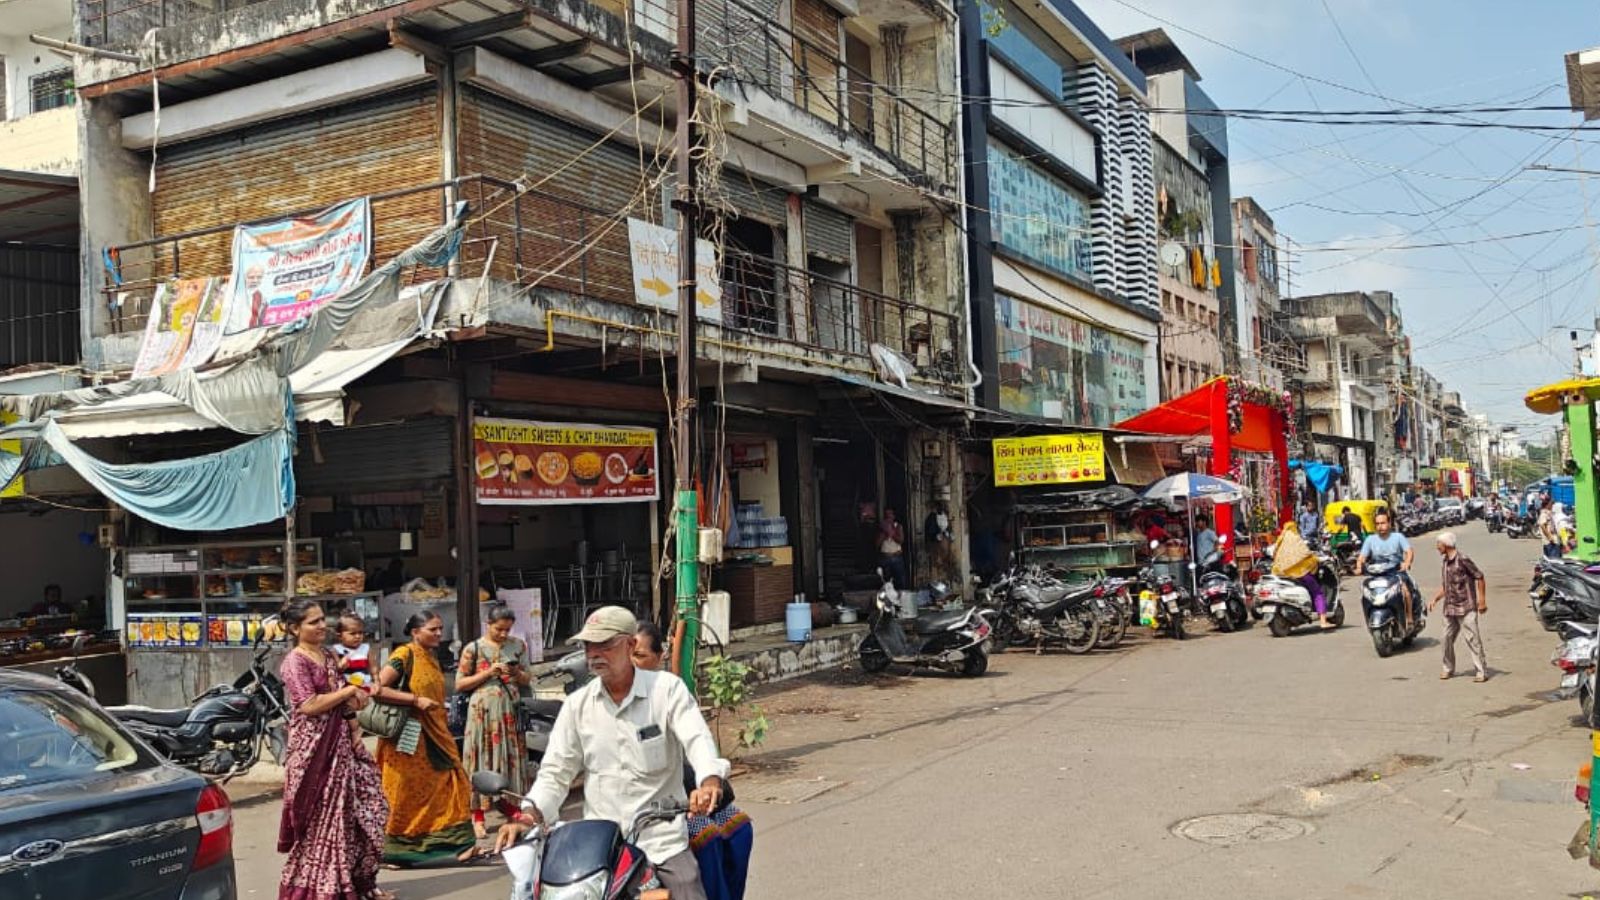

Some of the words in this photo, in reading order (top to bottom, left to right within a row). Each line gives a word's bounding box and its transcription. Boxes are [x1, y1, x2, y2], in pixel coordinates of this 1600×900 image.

[531, 427, 563, 443] SWEETS
[565, 429, 571, 443] &
[574, 430, 593, 444] CHAT
[129, 846, 188, 868] TITANIUM
